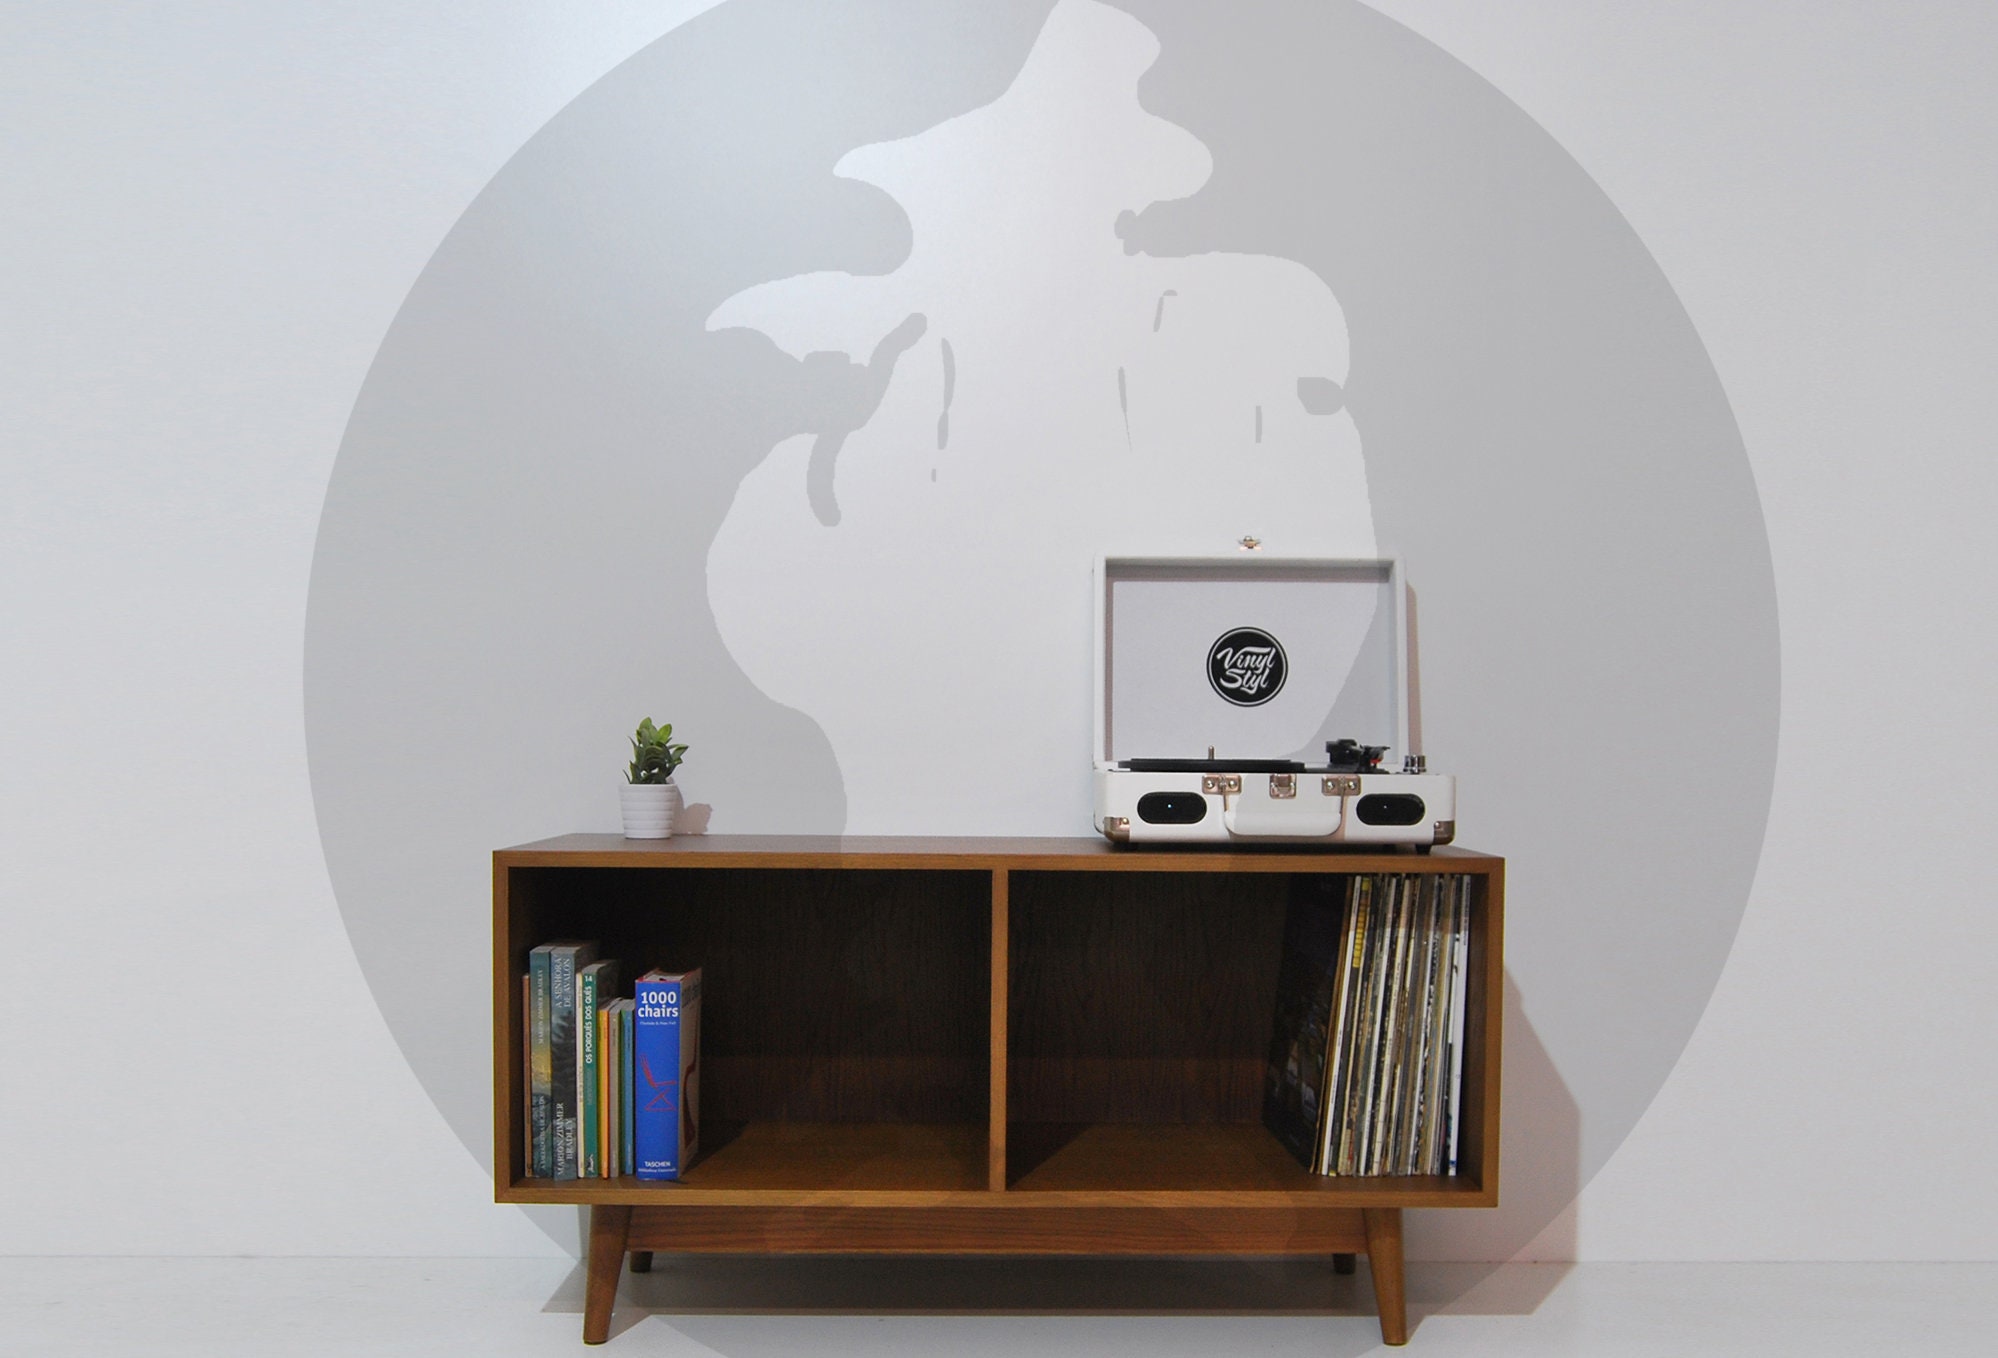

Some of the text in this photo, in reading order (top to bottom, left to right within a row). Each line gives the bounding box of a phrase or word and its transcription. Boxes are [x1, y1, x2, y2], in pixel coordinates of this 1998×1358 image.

[1216, 646, 1276, 674] Vinyl
[1220, 667, 1270, 695] Styl
[554, 958, 562, 1000] SENHORA
[563, 959, 571, 1007] DE AVALON
[584, 986, 592, 1004] QUÊS
[640, 991, 677, 1005] 1000
[584, 1005, 592, 1020] DOS
[637, 1004, 679, 1018] chairs
[584, 1021, 593, 1052] PORQUÊS
[585, 1053, 593, 1064] OS
[556, 1103, 565, 1175] MARION ZIMMER
[565, 1118, 573, 1160] BRADLEY
